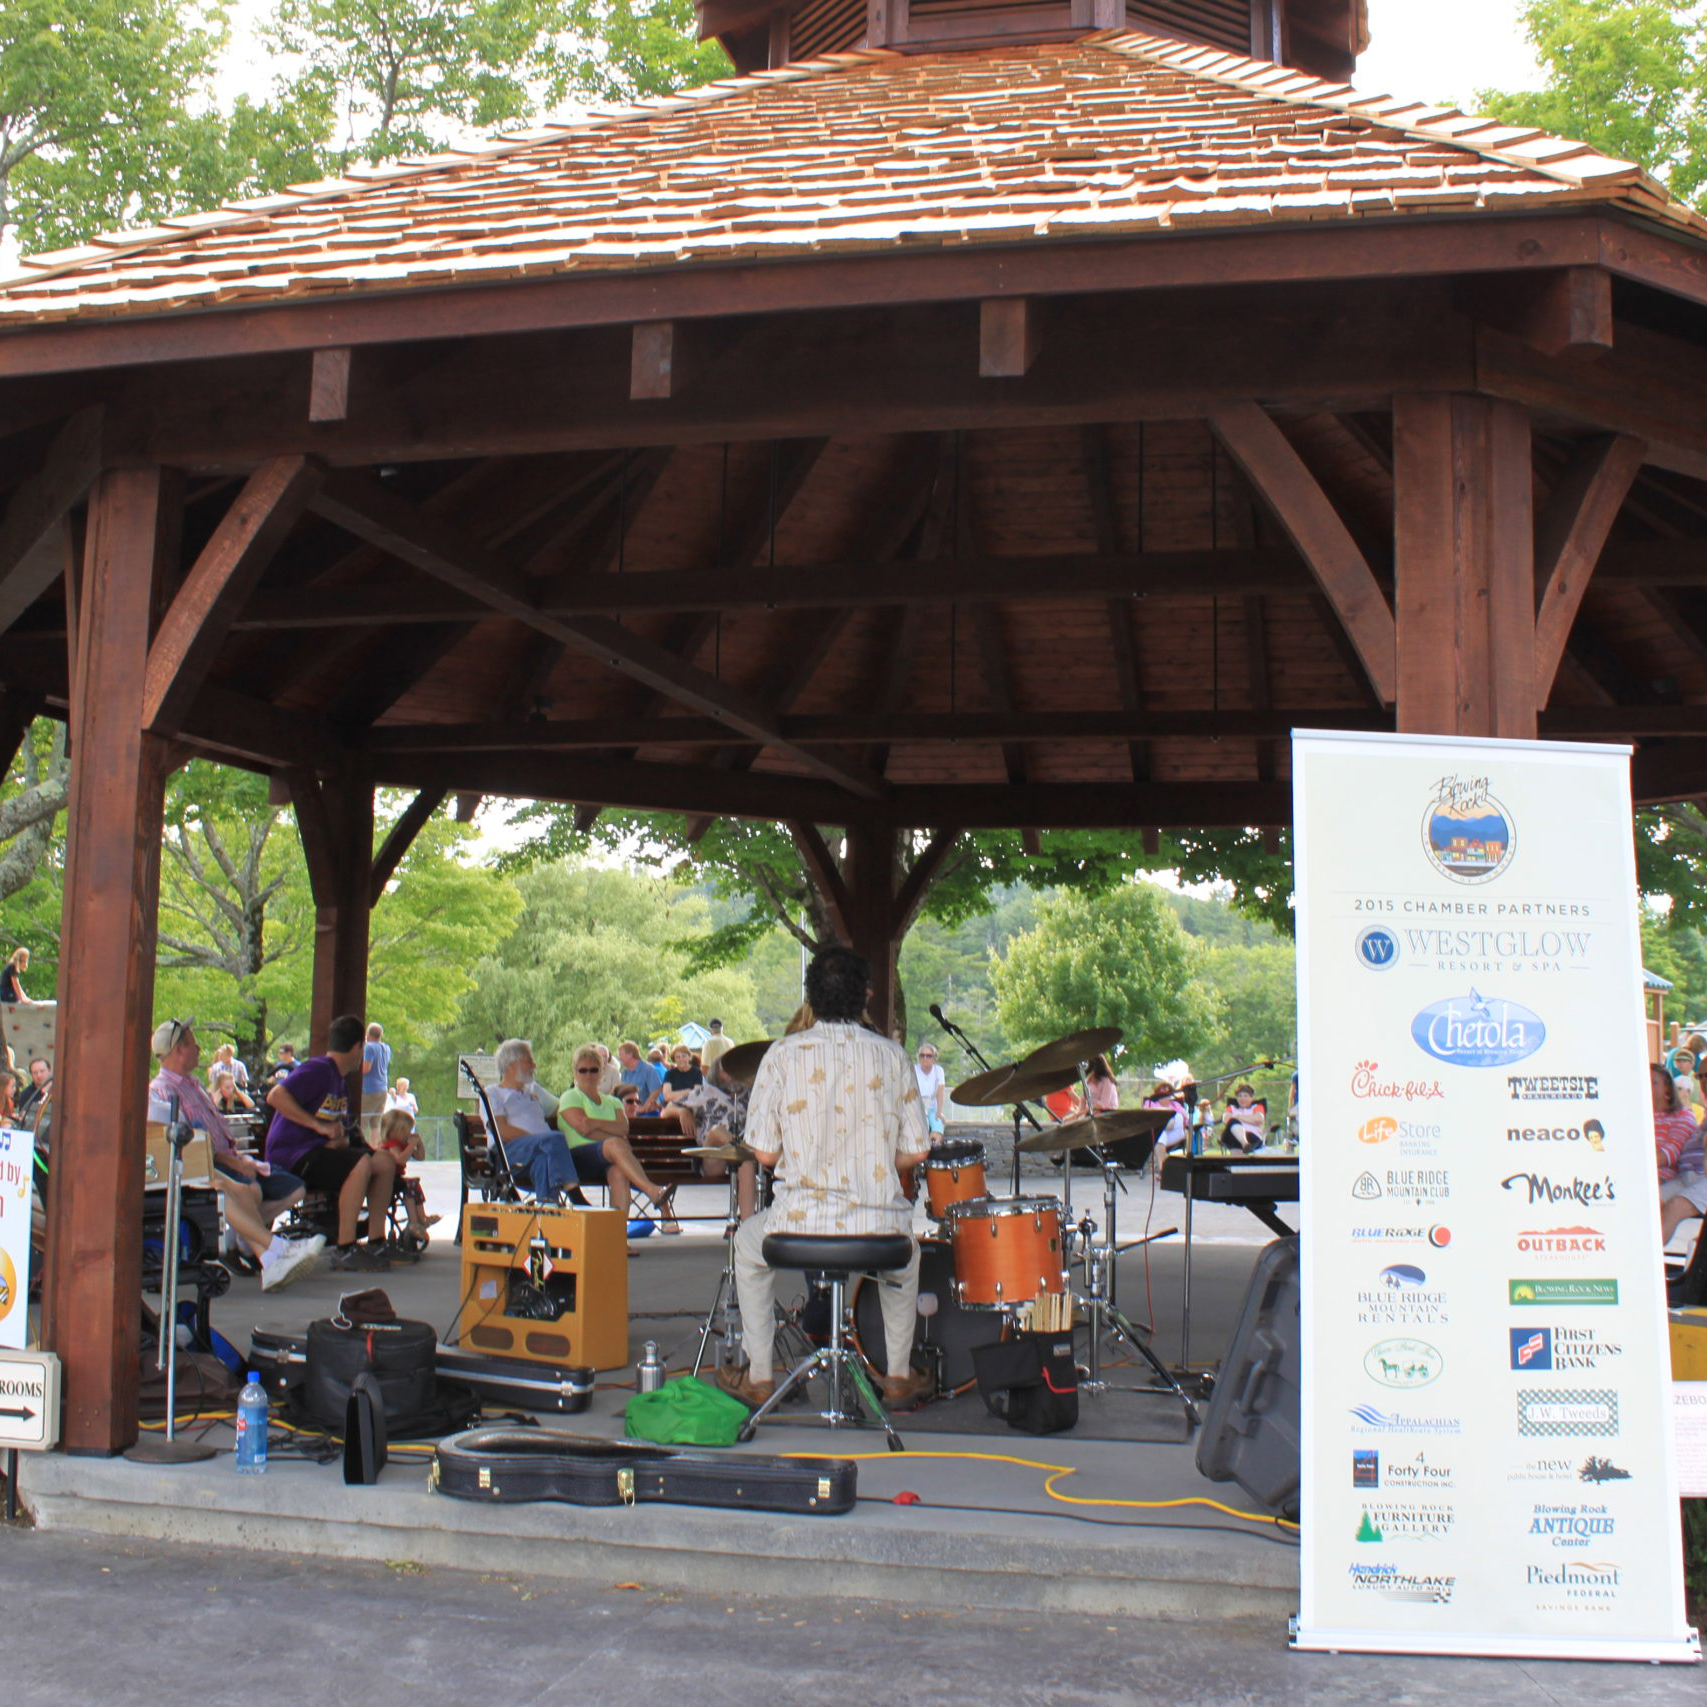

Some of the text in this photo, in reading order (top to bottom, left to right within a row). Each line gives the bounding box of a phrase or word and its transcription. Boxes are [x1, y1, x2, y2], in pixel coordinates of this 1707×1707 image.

[1429, 773, 1491, 801] Blowing
[1447, 793, 1482, 818] Rock
[1354, 899, 1590, 917] 2015 CHAMBER PARTNERS
[1403, 928, 1593, 958] WESTGLOW
[1437, 961, 1561, 972] RESORT & SPA
[1428, 1001, 1527, 1056] Chetola
[1507, 1075, 1599, 1100] TWEETSIE
[1361, 1119, 1441, 1142] Life Store
[1507, 1127, 1580, 1141] neaco
[7, 1161, 21, 1186] by
[1386, 1170, 1449, 1185] BLUE RIDGE
[1386, 1186, 1450, 1197] MOUNTAIN CLUB
[1501, 1172, 1615, 1206] Monkee's
[1517, 1238, 1606, 1251] OUTBACK
[1358, 1292, 1448, 1304] BLUE RIDGE
[1368, 1304, 1439, 1313] MOUNTAIN
[1358, 1313, 1449, 1323] RENTALS
[1554, 1327, 1595, 1340] FIRST
[1554, 1342, 1622, 1355] CITIZENS
[1555, 1357, 1596, 1370] BANK
[1528, 1406, 1607, 1419] J.W. Tweeds
[1415, 1451, 1425, 1464] 4
[1387, 1464, 1419, 1478] Forty
[1423, 1466, 1451, 1477] Four
[1538, 1459, 1572, 1471] new
[1533, 1504, 1608, 1515] Blowing Rock
[1373, 1512, 1455, 1523] FURNITURE
[1381, 1523, 1450, 1533] GALLERY
[1528, 1517, 1615, 1538] ANTIQUE
[1551, 1536, 1591, 1547] Center
[1348, 1562, 1398, 1577] Hendrick
[1526, 1562, 1619, 1585] Piedmont
[1354, 1574, 1456, 1586] NORTHLAKE
[1567, 1589, 1616, 1598] FEDERAL
